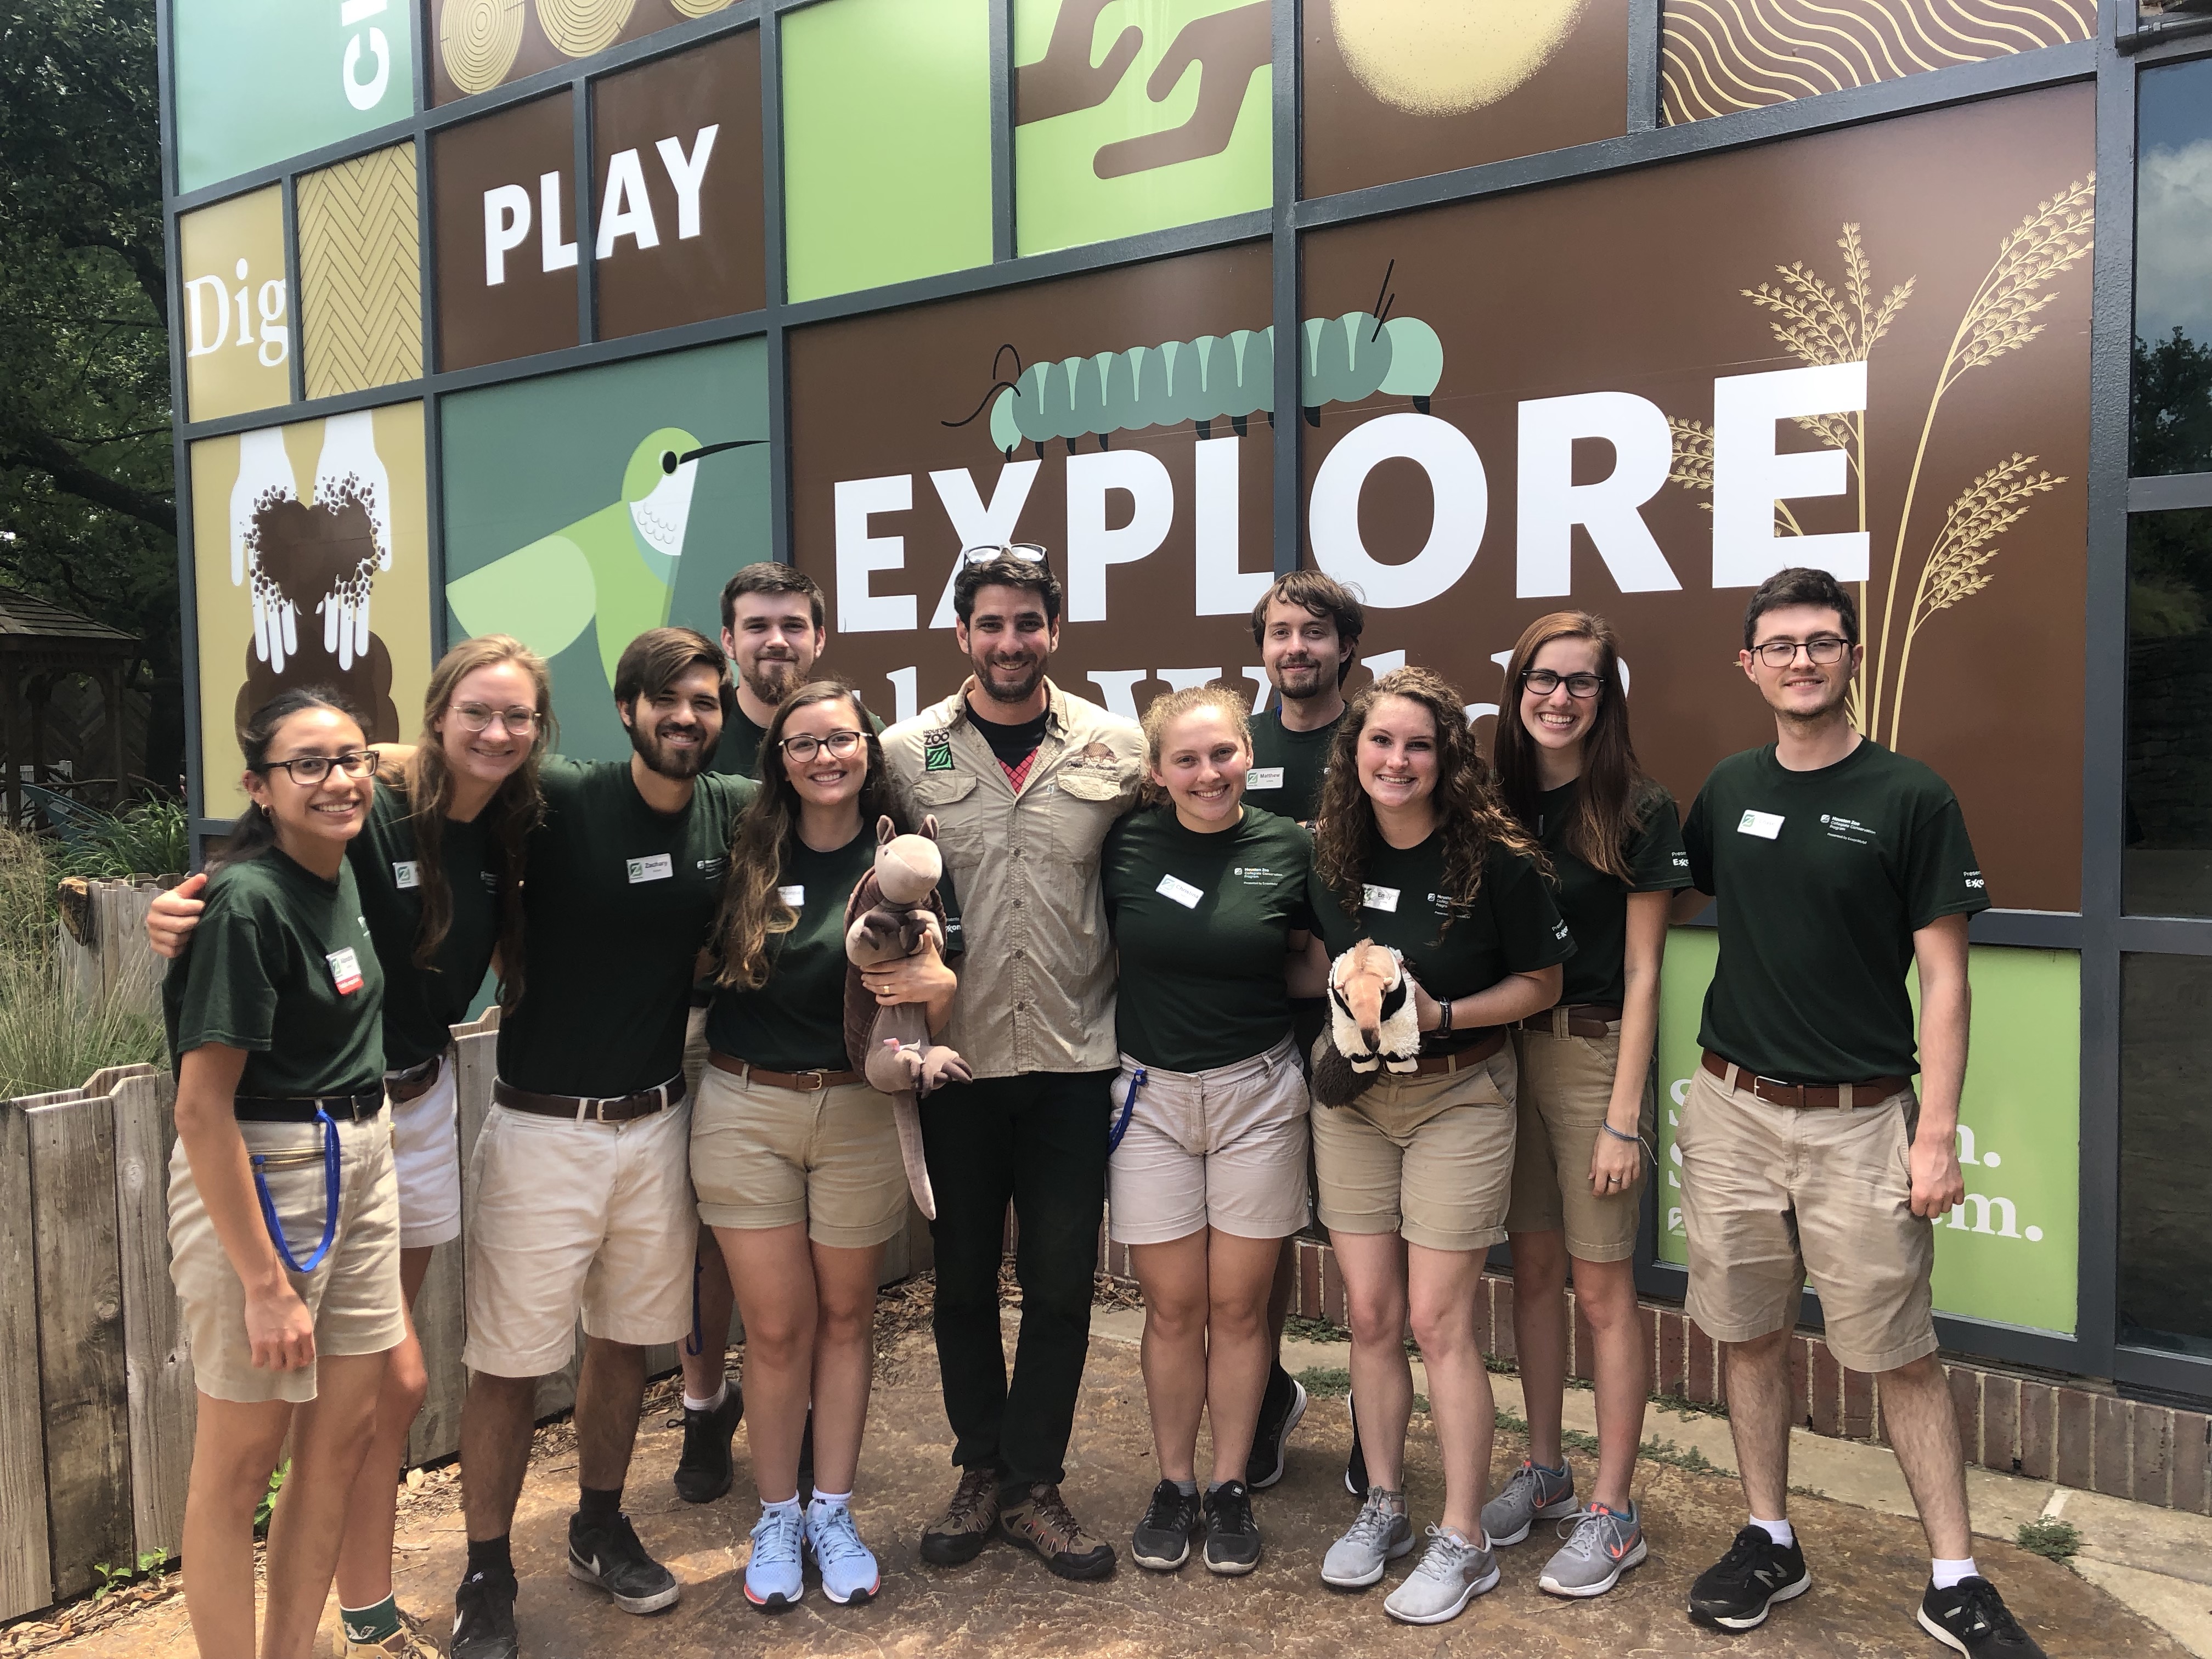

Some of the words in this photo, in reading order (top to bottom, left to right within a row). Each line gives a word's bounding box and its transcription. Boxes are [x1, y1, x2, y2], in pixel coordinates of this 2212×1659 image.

[483, 123, 720, 286] PLAY
[184, 257, 289, 367] Dig
[833, 360, 1871, 633] EXPLORE
[923, 731, 950, 745] ZOO
[1176, 884, 1199, 899] Christina
